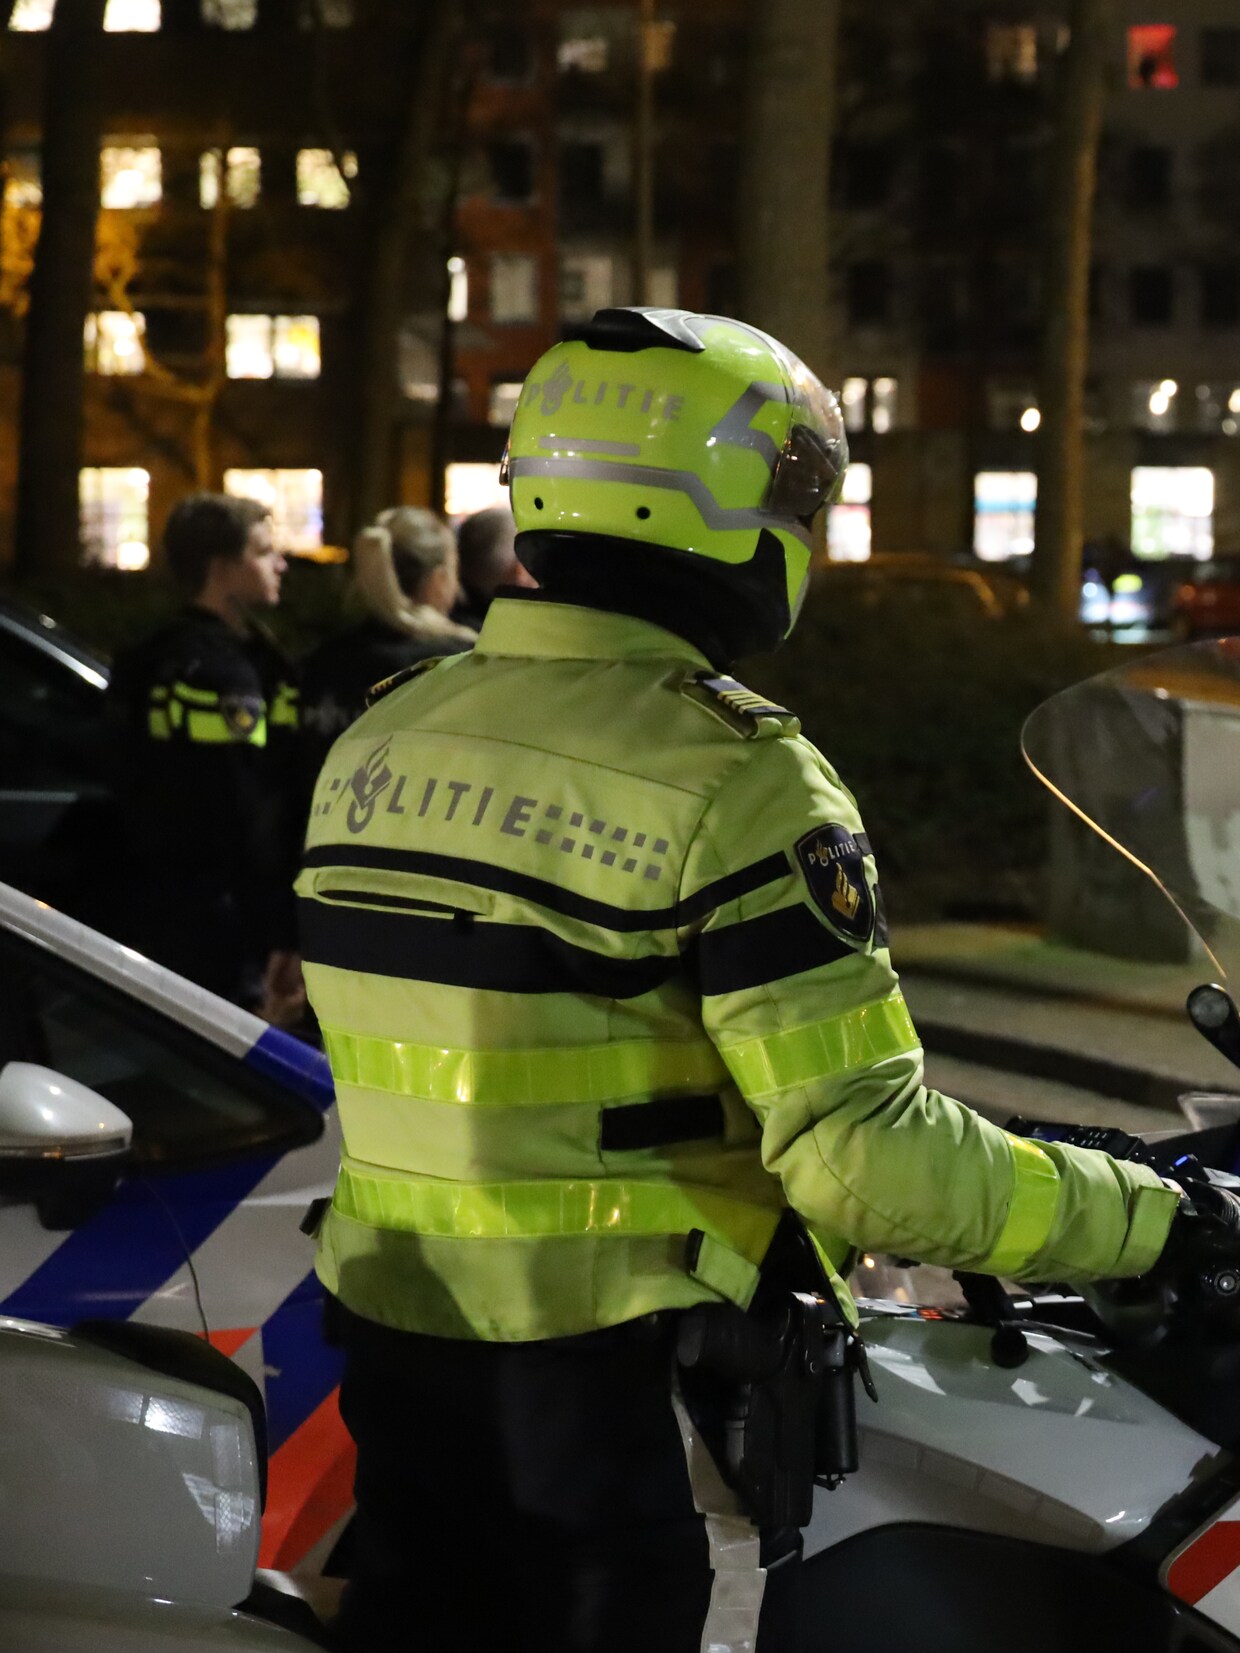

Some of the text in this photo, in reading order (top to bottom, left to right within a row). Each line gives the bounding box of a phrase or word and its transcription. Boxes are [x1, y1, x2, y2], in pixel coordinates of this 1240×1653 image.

[525, 364, 685, 420] POLITIE
[337, 752, 537, 837] OLITIE
[808, 839, 857, 867] POLITIE
